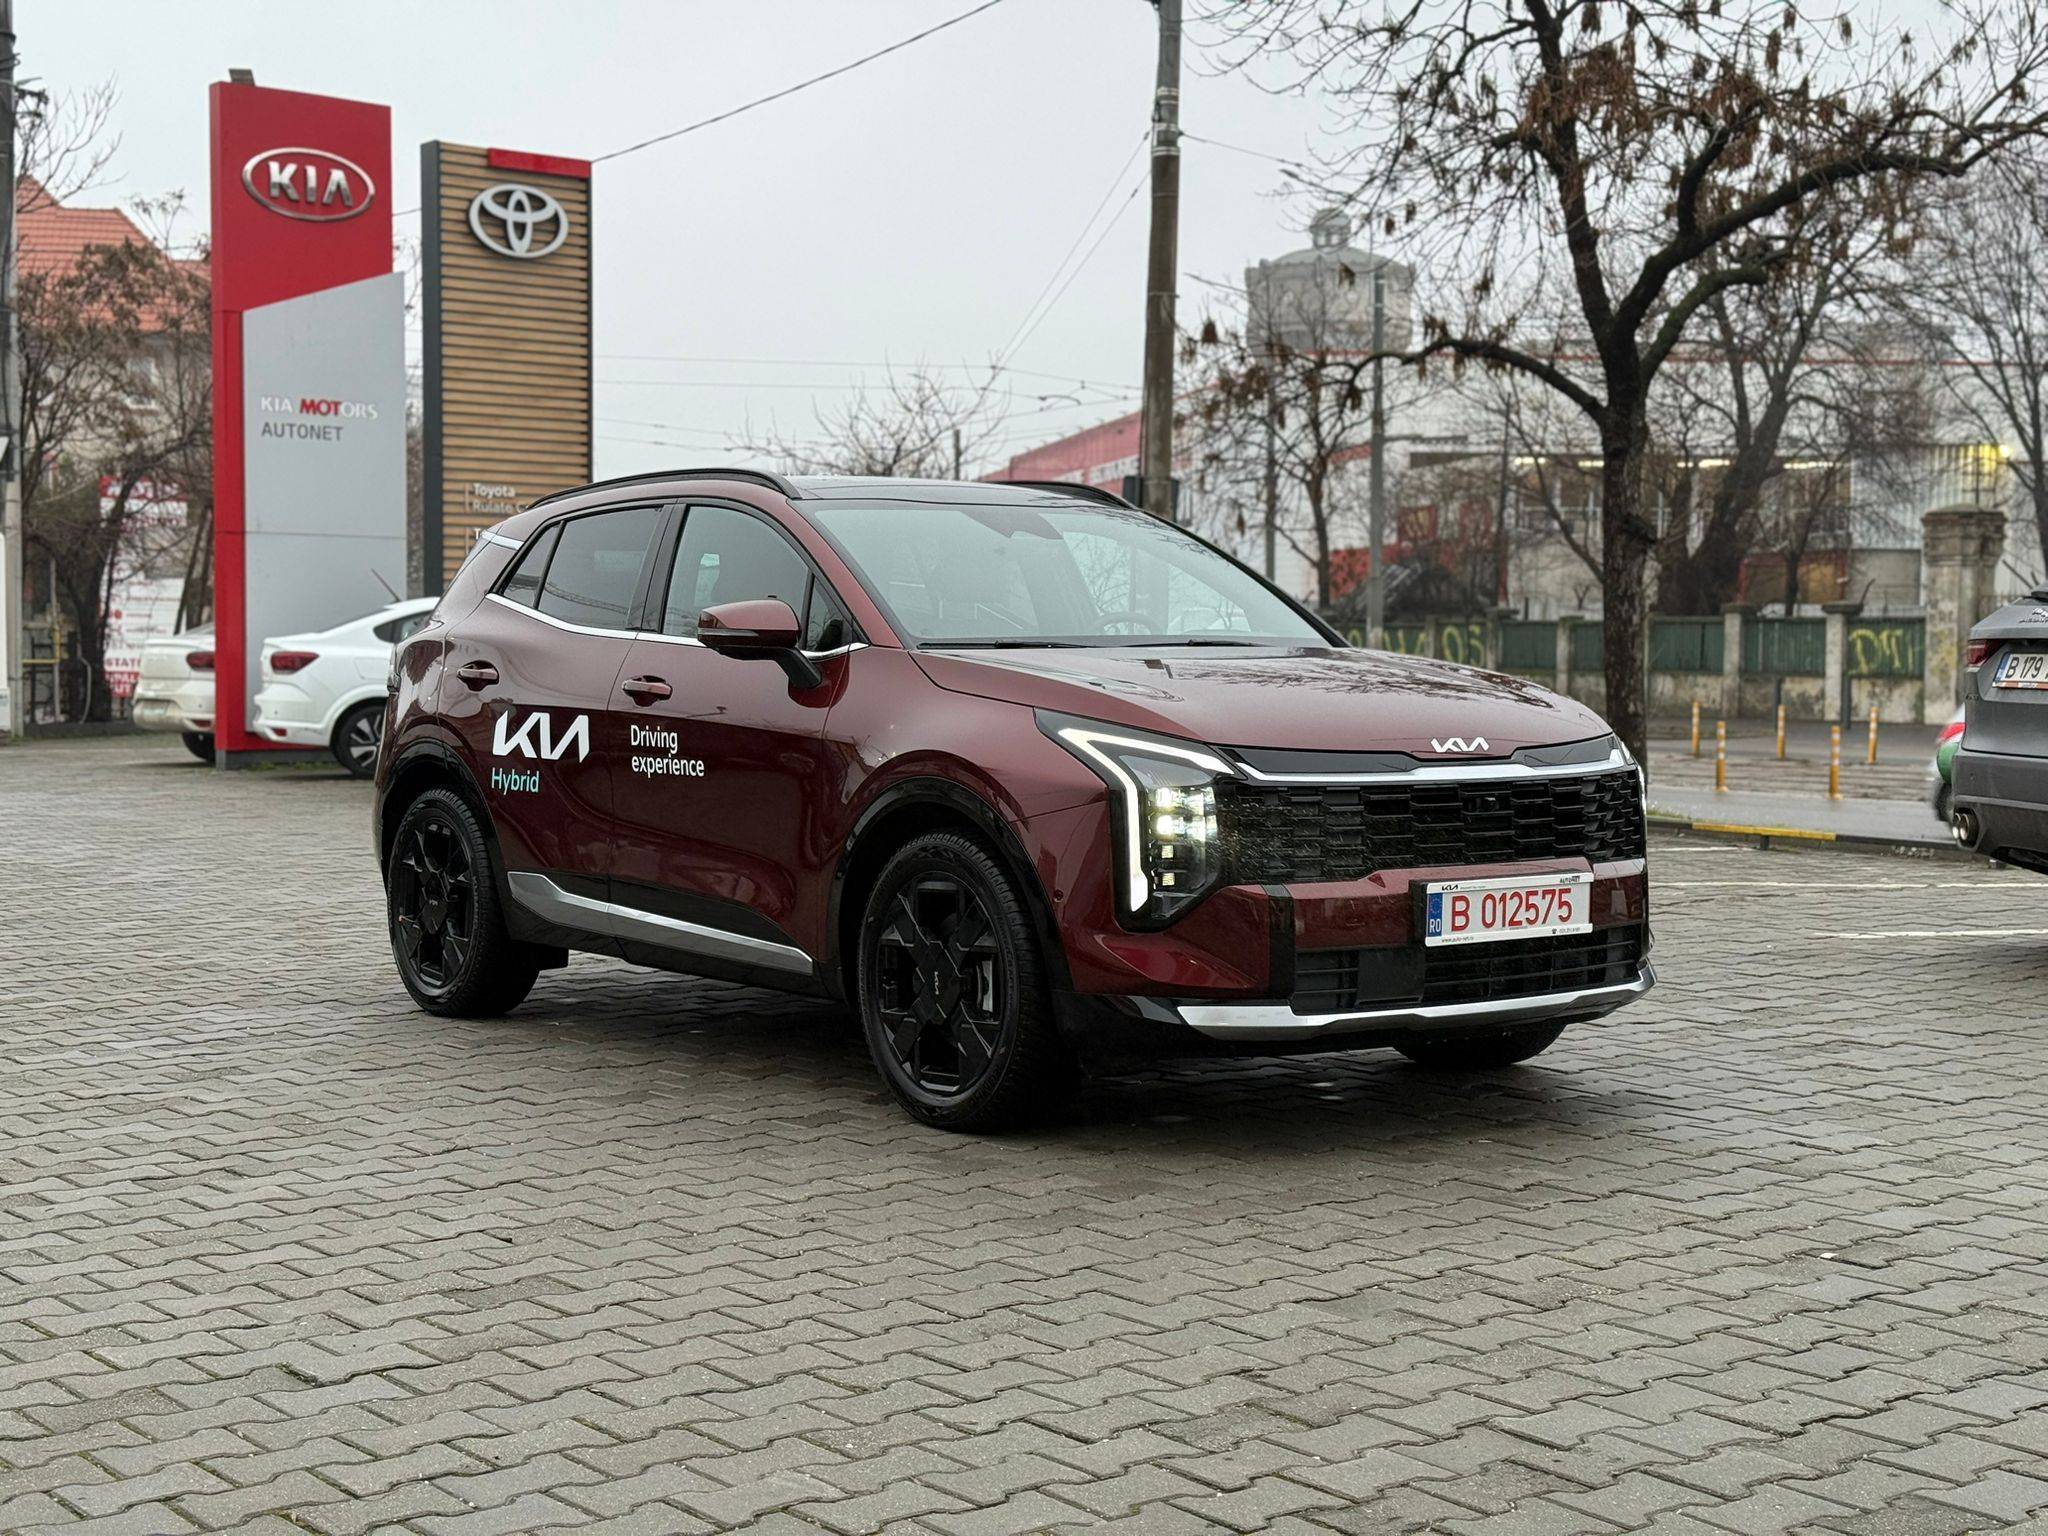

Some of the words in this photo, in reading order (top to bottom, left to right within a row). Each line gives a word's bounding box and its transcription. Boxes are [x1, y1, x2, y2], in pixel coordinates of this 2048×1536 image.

[268, 161, 353, 207] KIA
[261, 397, 293, 413] KIA
[299, 399, 379, 419] MOTORS
[261, 422, 344, 441] AUTONET
[473, 483, 516, 499] Toyota
[2005, 657, 2020, 678] B
[2020, 656, 2043, 679] 179
[492, 710, 590, 763] KIA
[630, 724, 678, 754] Driving
[1430, 736, 1490, 753] KIA
[631, 753, 705, 778] experience
[491, 767, 540, 795] Hybrid
[1451, 895, 1470, 932] B
[1481, 888, 1572, 929] 012575
[1429, 918, 1442, 933] RO
